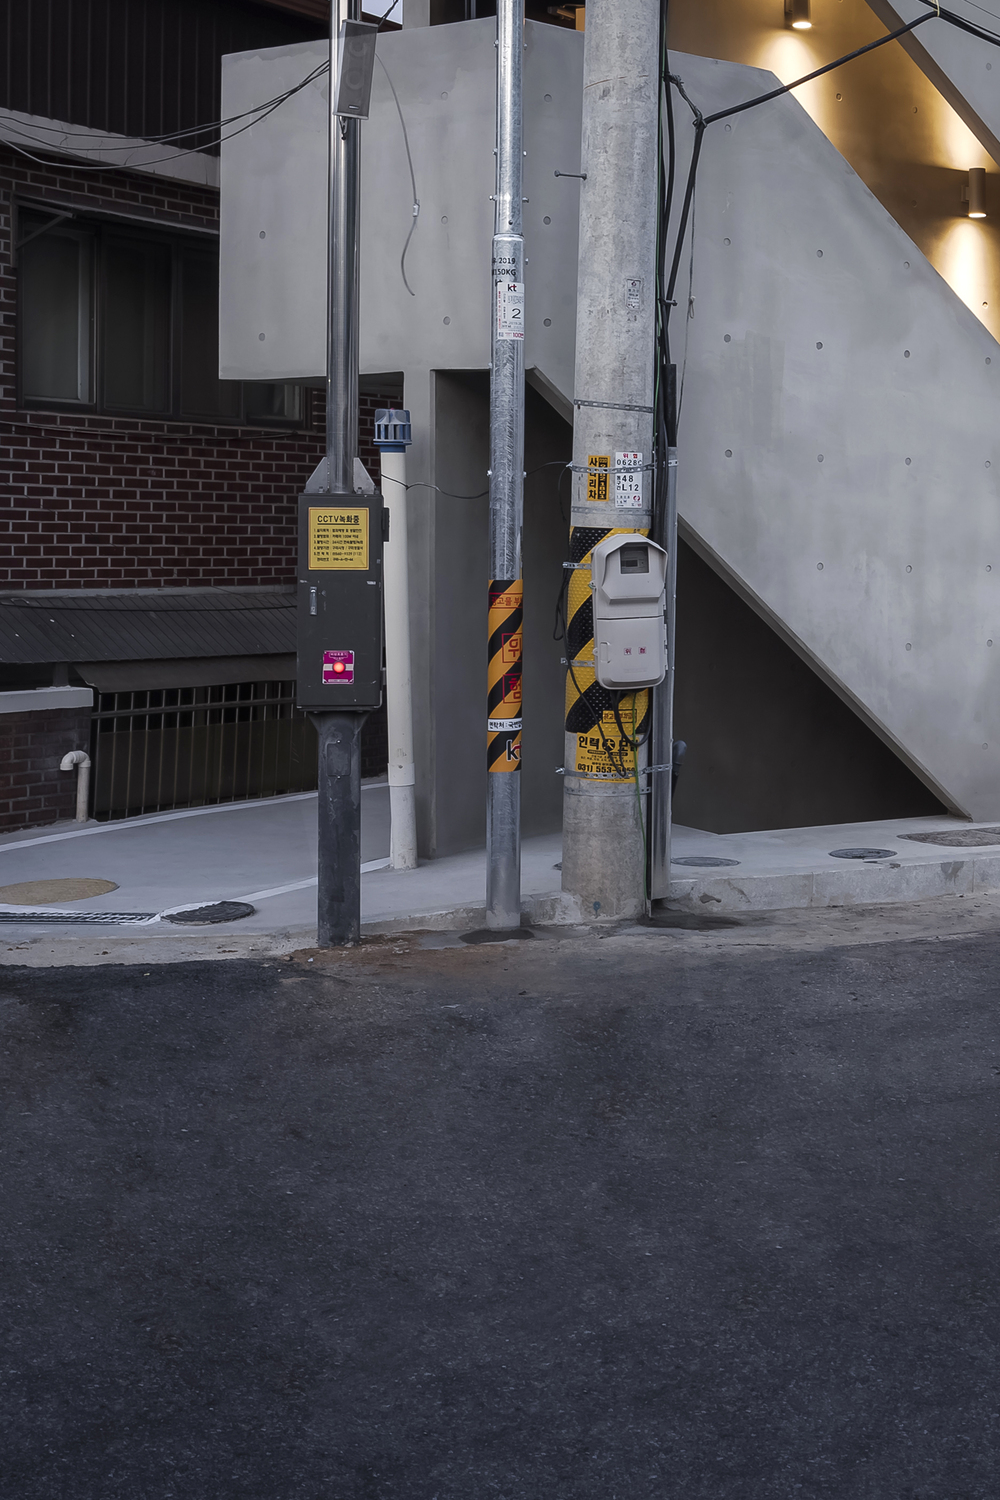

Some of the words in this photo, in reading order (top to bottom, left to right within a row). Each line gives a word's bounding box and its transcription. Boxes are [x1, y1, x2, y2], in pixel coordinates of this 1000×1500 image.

[492, 268, 517, 276] 150KG
[512, 308, 521, 319] 2
[621, 475, 634, 483] 48
[578, 735, 600, 750] 인력
